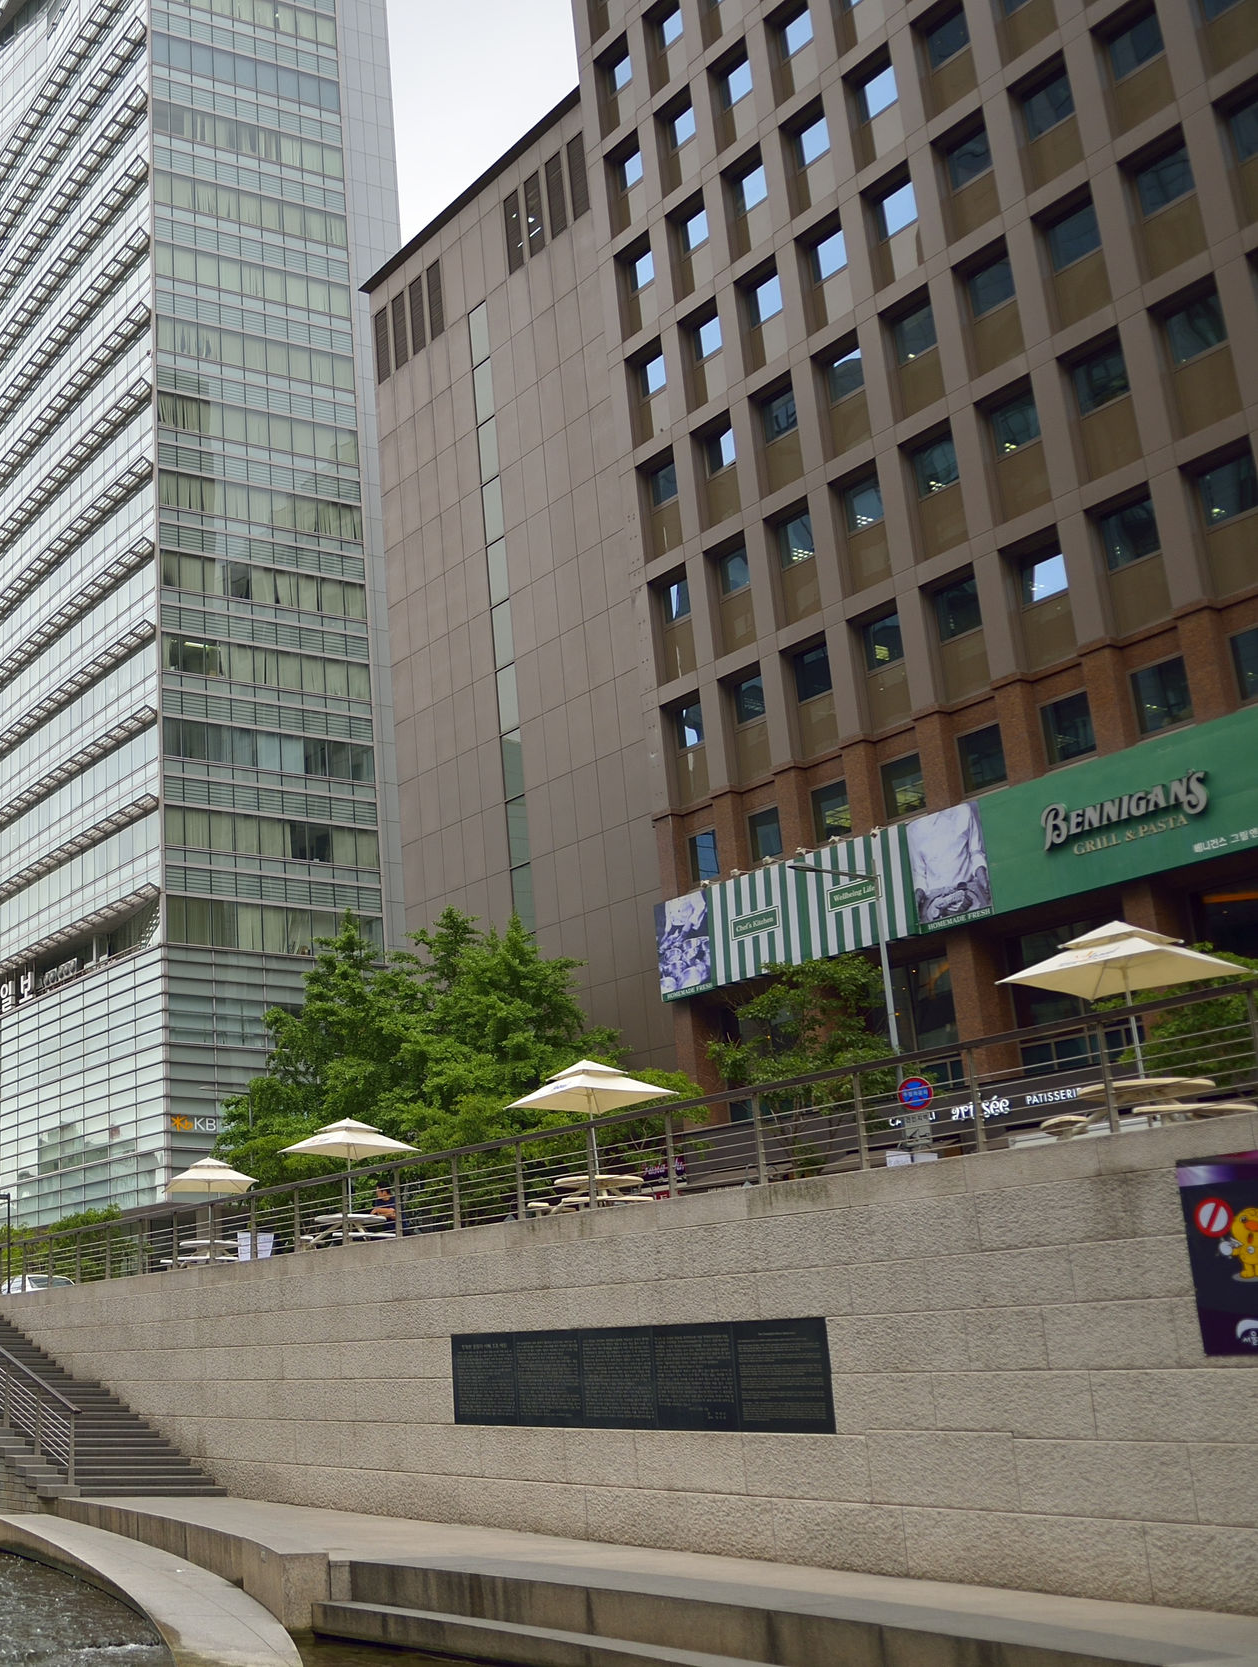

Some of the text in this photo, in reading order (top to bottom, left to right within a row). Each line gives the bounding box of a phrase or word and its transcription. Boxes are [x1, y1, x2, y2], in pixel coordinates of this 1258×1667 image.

[1041, 769, 1208, 851] BENNIGAN'S
[1073, 814, 1189, 856] GRILL & PASTA
[928, 907, 991, 931] HOMEMADE FRESH
[193, 1116, 217, 1132] KB
